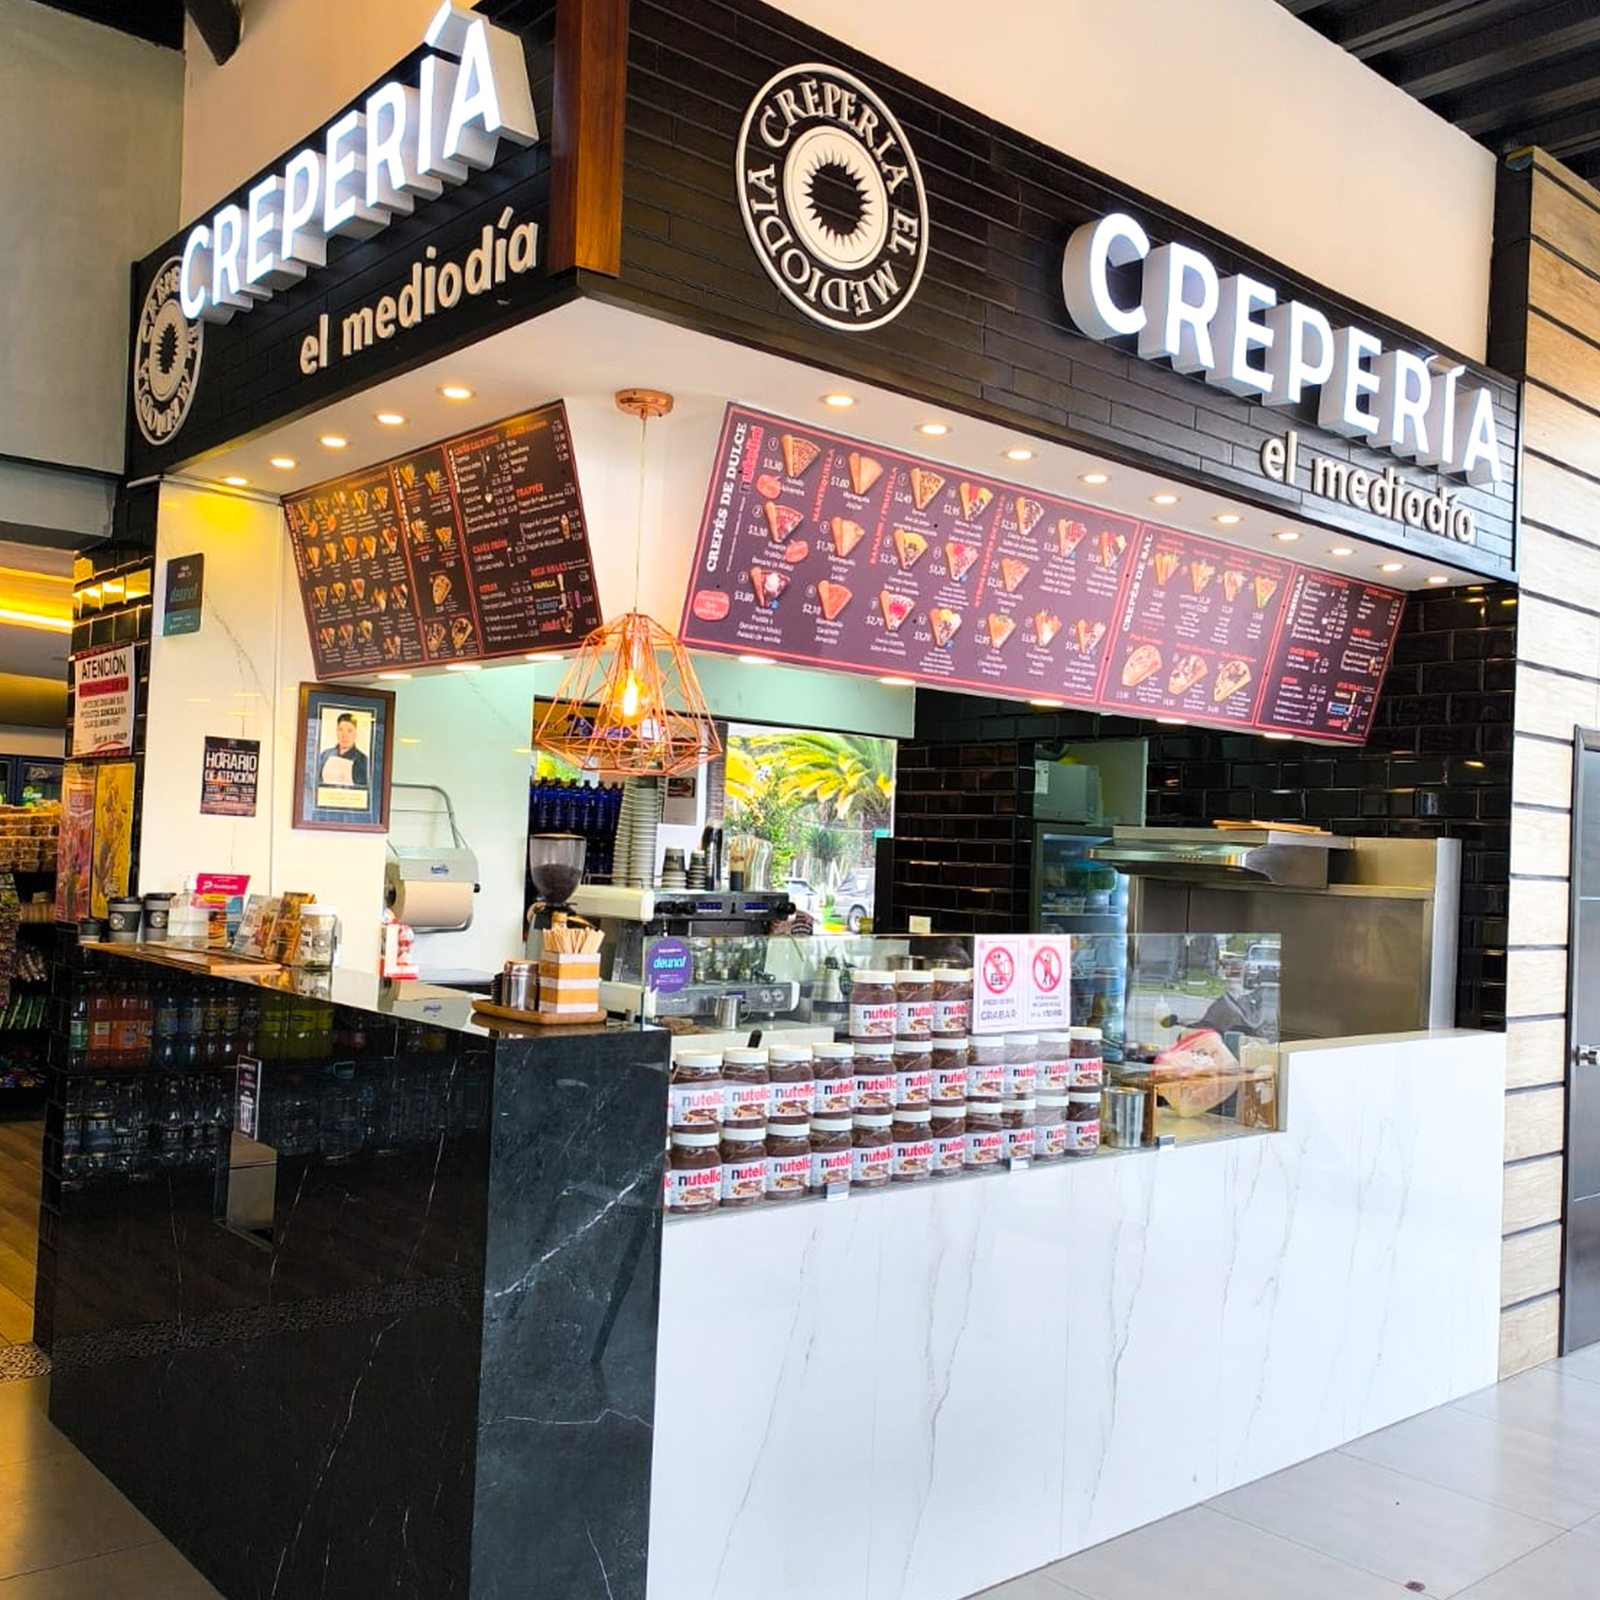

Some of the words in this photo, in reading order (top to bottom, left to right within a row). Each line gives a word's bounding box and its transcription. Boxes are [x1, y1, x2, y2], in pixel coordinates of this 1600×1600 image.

[180, 0, 501, 320] CREPERÍA
[760, 78, 909, 195] CREPERIA
[747, 164, 901, 316] MEDIODIA
[888, 209, 919, 256] EL
[300, 314, 330, 374] el
[342, 206, 538, 356] mediodía
[1090, 212, 1502, 483] CREPERÍA
[720, 482, 734, 506] DE
[725, 422, 748, 479] DULCE
[1261, 430, 1298, 484] el
[1311, 456, 1475, 544] mediodía
[706, 508, 729, 573] CREPÉS
[205, 752, 257, 772] HORARIO
